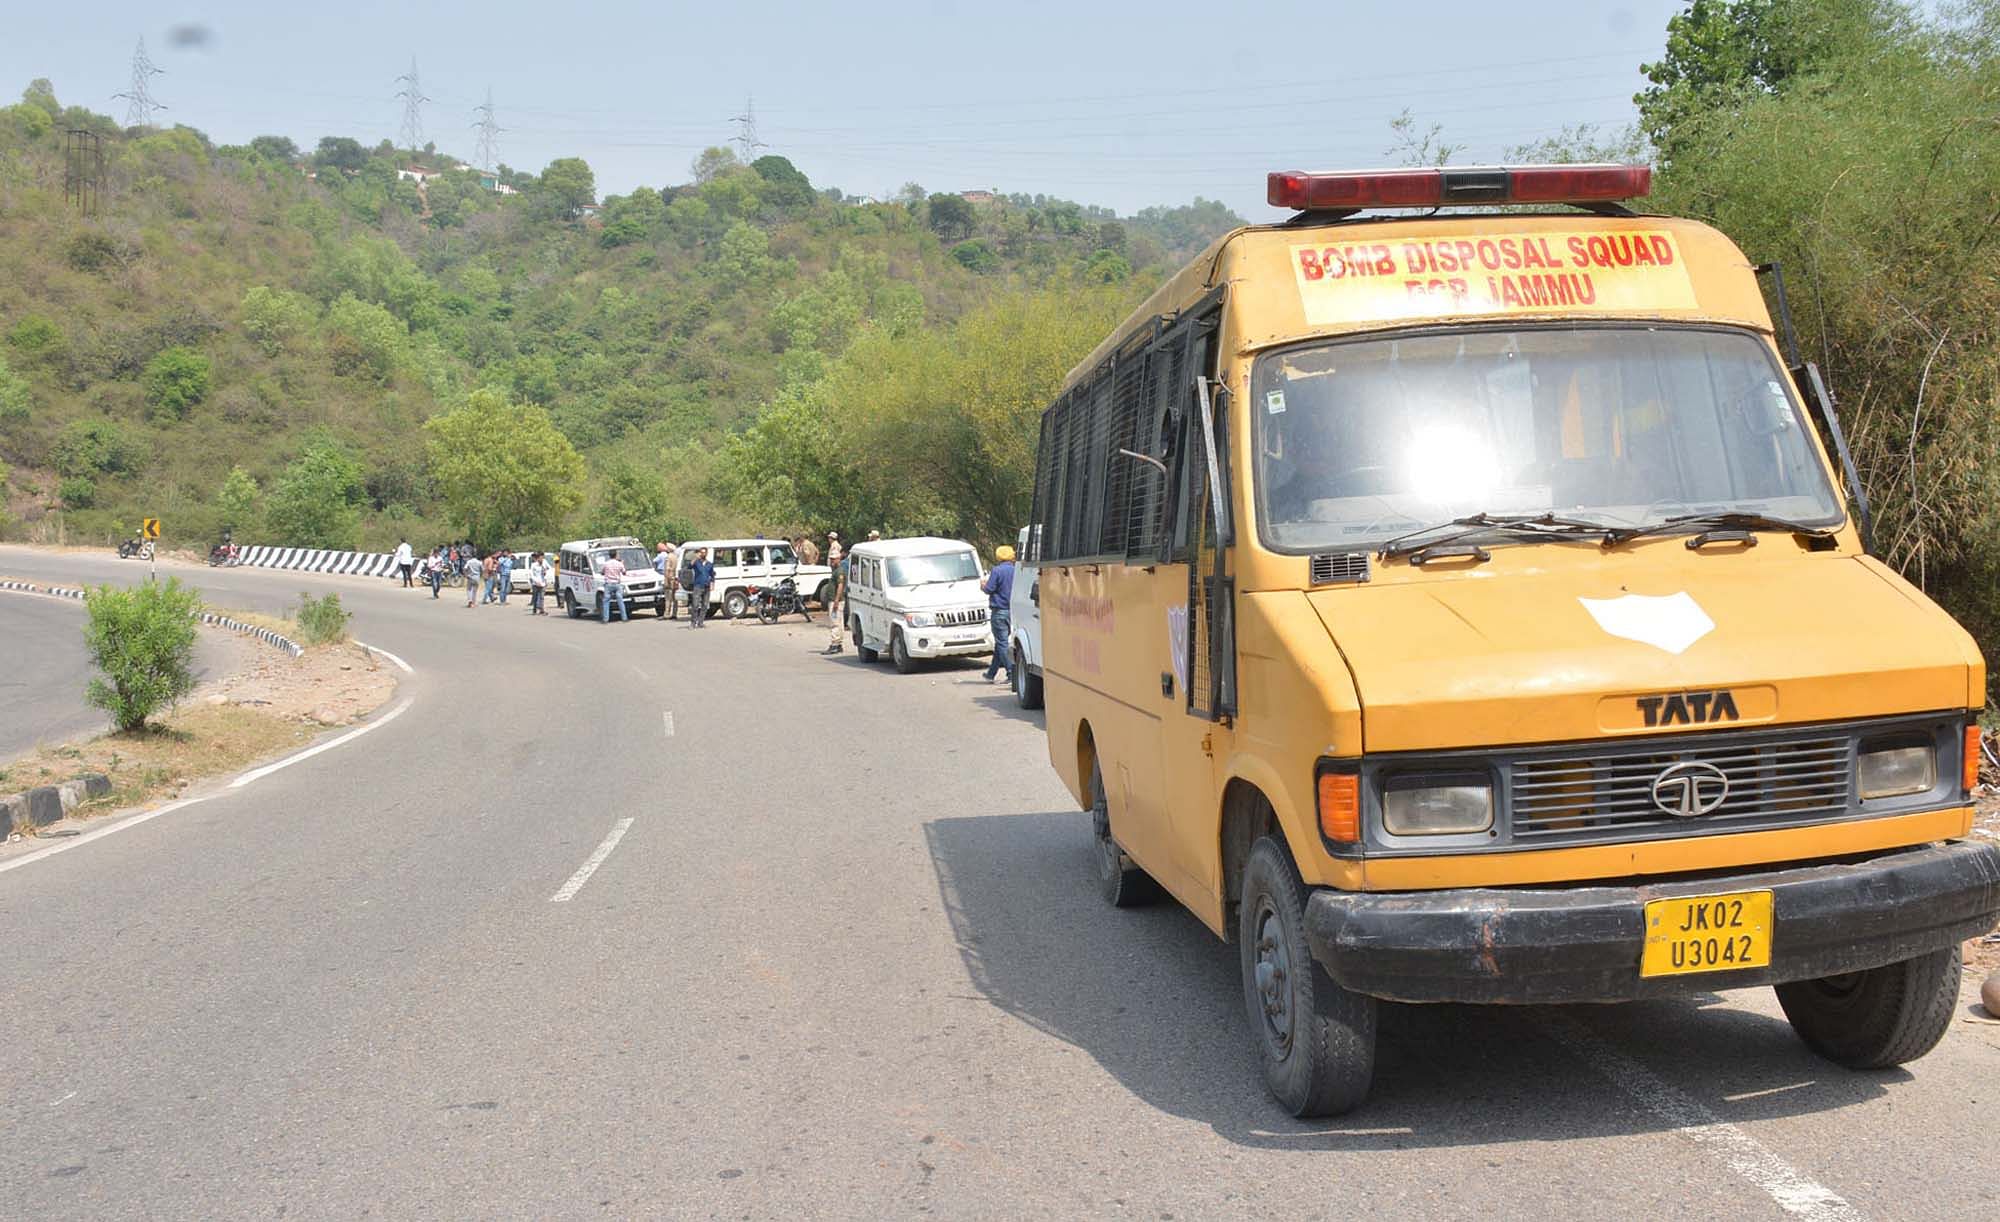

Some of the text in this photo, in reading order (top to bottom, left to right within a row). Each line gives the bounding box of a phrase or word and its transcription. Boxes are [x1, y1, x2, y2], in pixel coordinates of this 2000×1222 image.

[1299, 234, 1674, 281] BOMB DISPOSAL SQUAD
[1486, 273, 1597, 309] JAMMU
[1636, 691, 1740, 728] TATA
[1679, 900, 1744, 932] JK02
[1671, 935, 1753, 969] U3042
